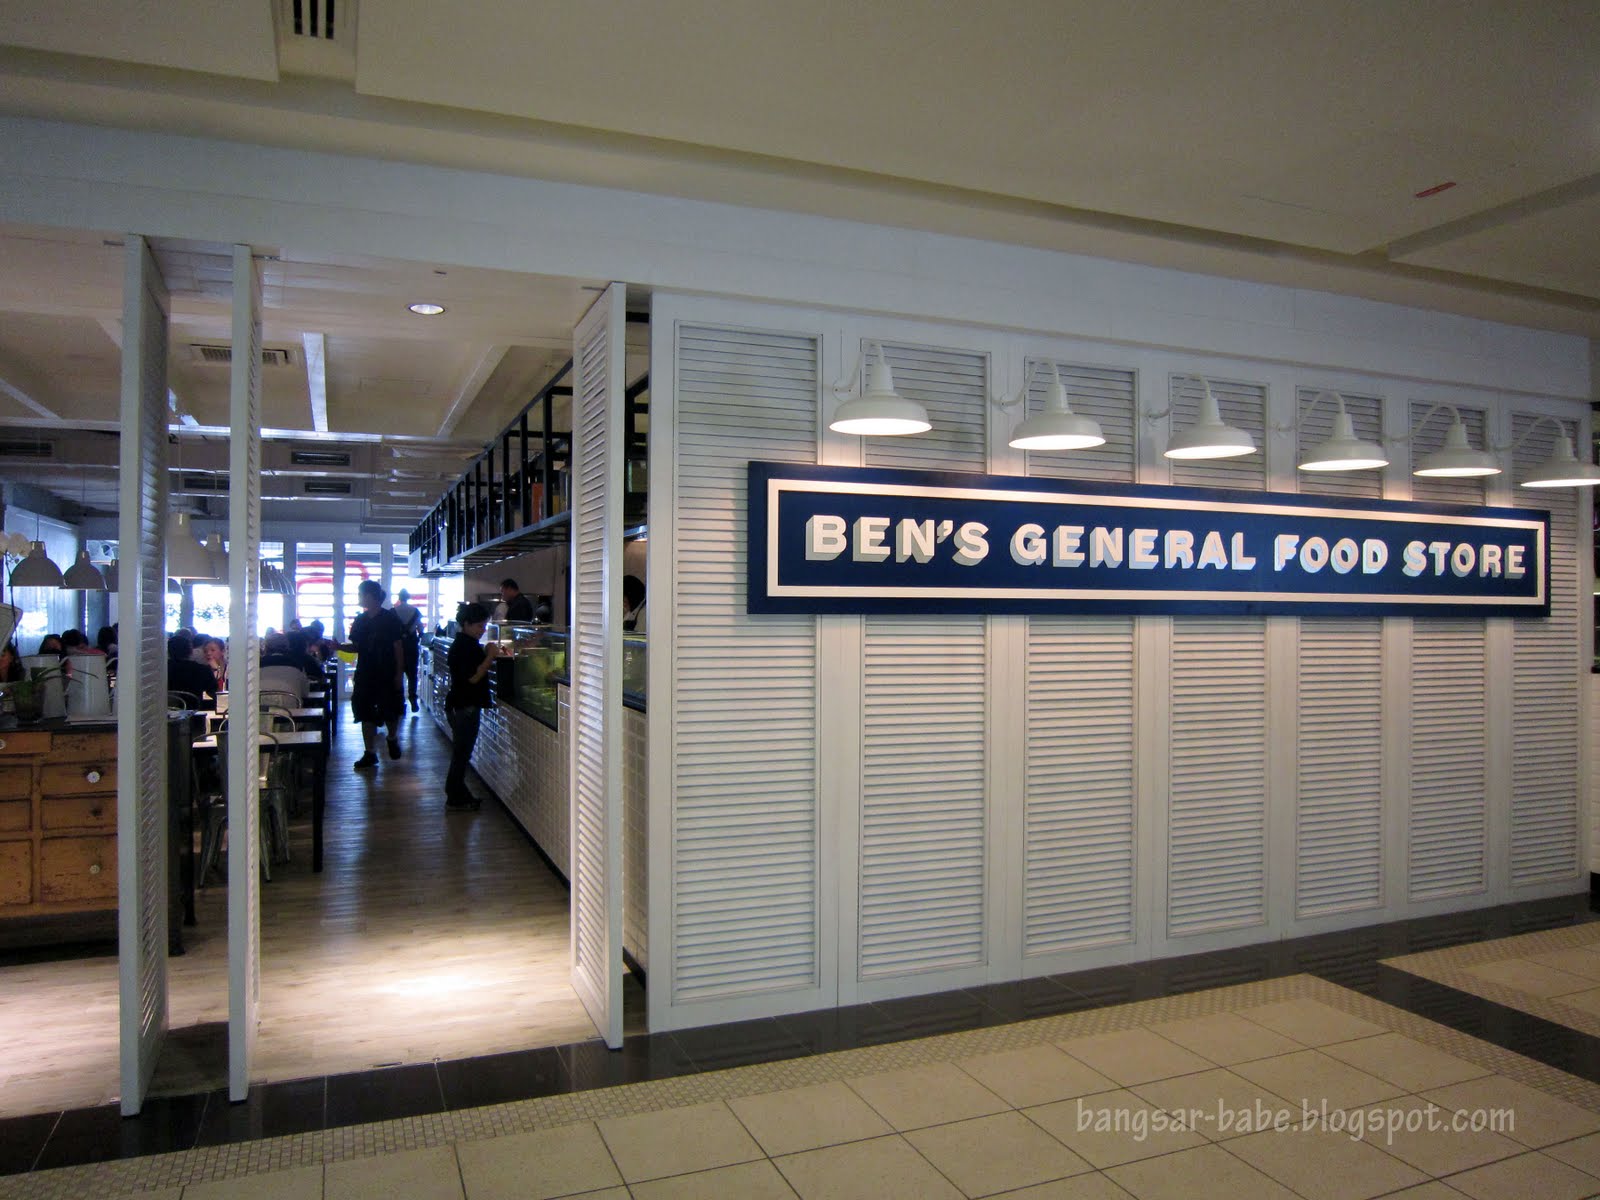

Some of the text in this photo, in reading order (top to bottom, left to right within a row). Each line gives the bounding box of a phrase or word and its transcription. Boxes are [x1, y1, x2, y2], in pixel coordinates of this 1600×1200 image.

[805, 514, 1526, 580] BEN'S GENERAL FOOD STORE
